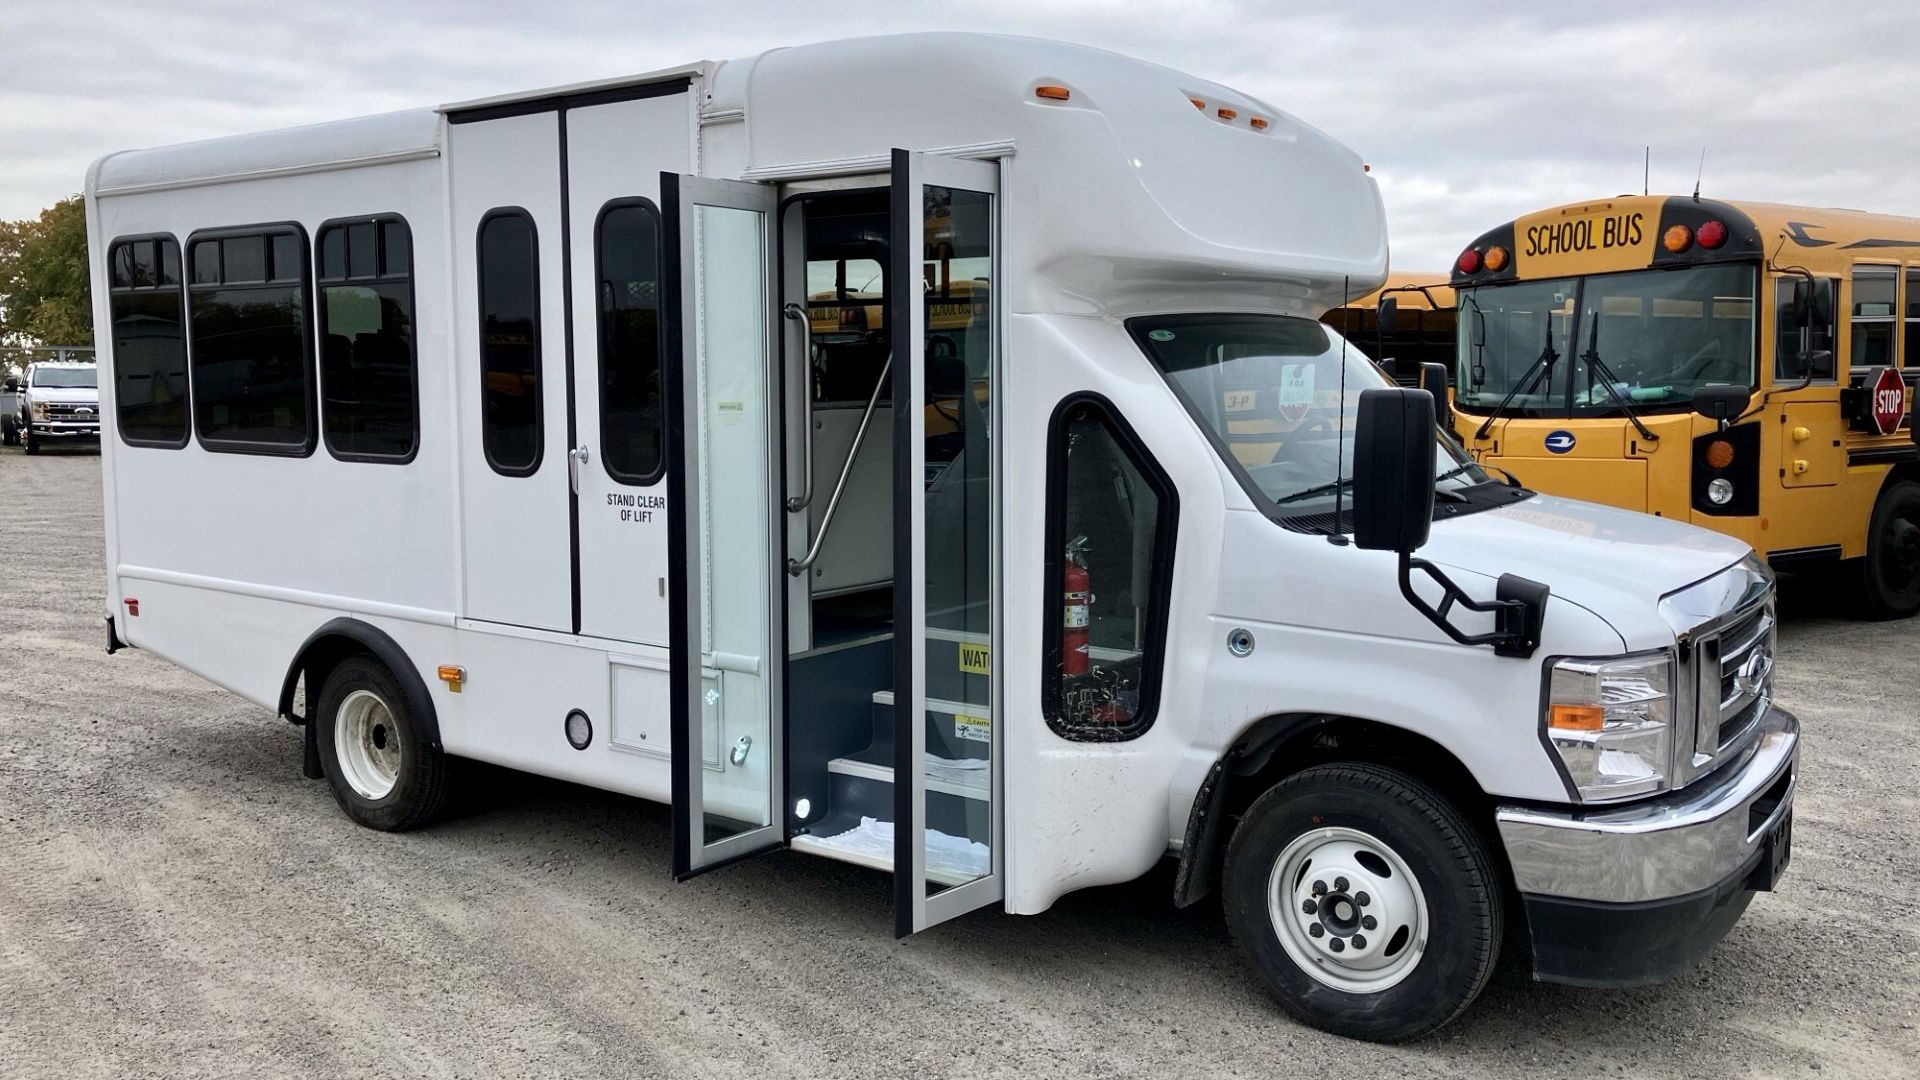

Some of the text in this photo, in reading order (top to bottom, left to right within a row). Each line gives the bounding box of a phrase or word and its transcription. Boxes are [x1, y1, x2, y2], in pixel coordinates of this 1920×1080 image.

[1526, 212, 1643, 257] SCHOOL BUS
[1878, 389, 1901, 414] STOP
[607, 493, 665, 509] STAND CLEAR
[620, 509, 652, 523] OF LIFT
[962, 649, 990, 669] WAT
